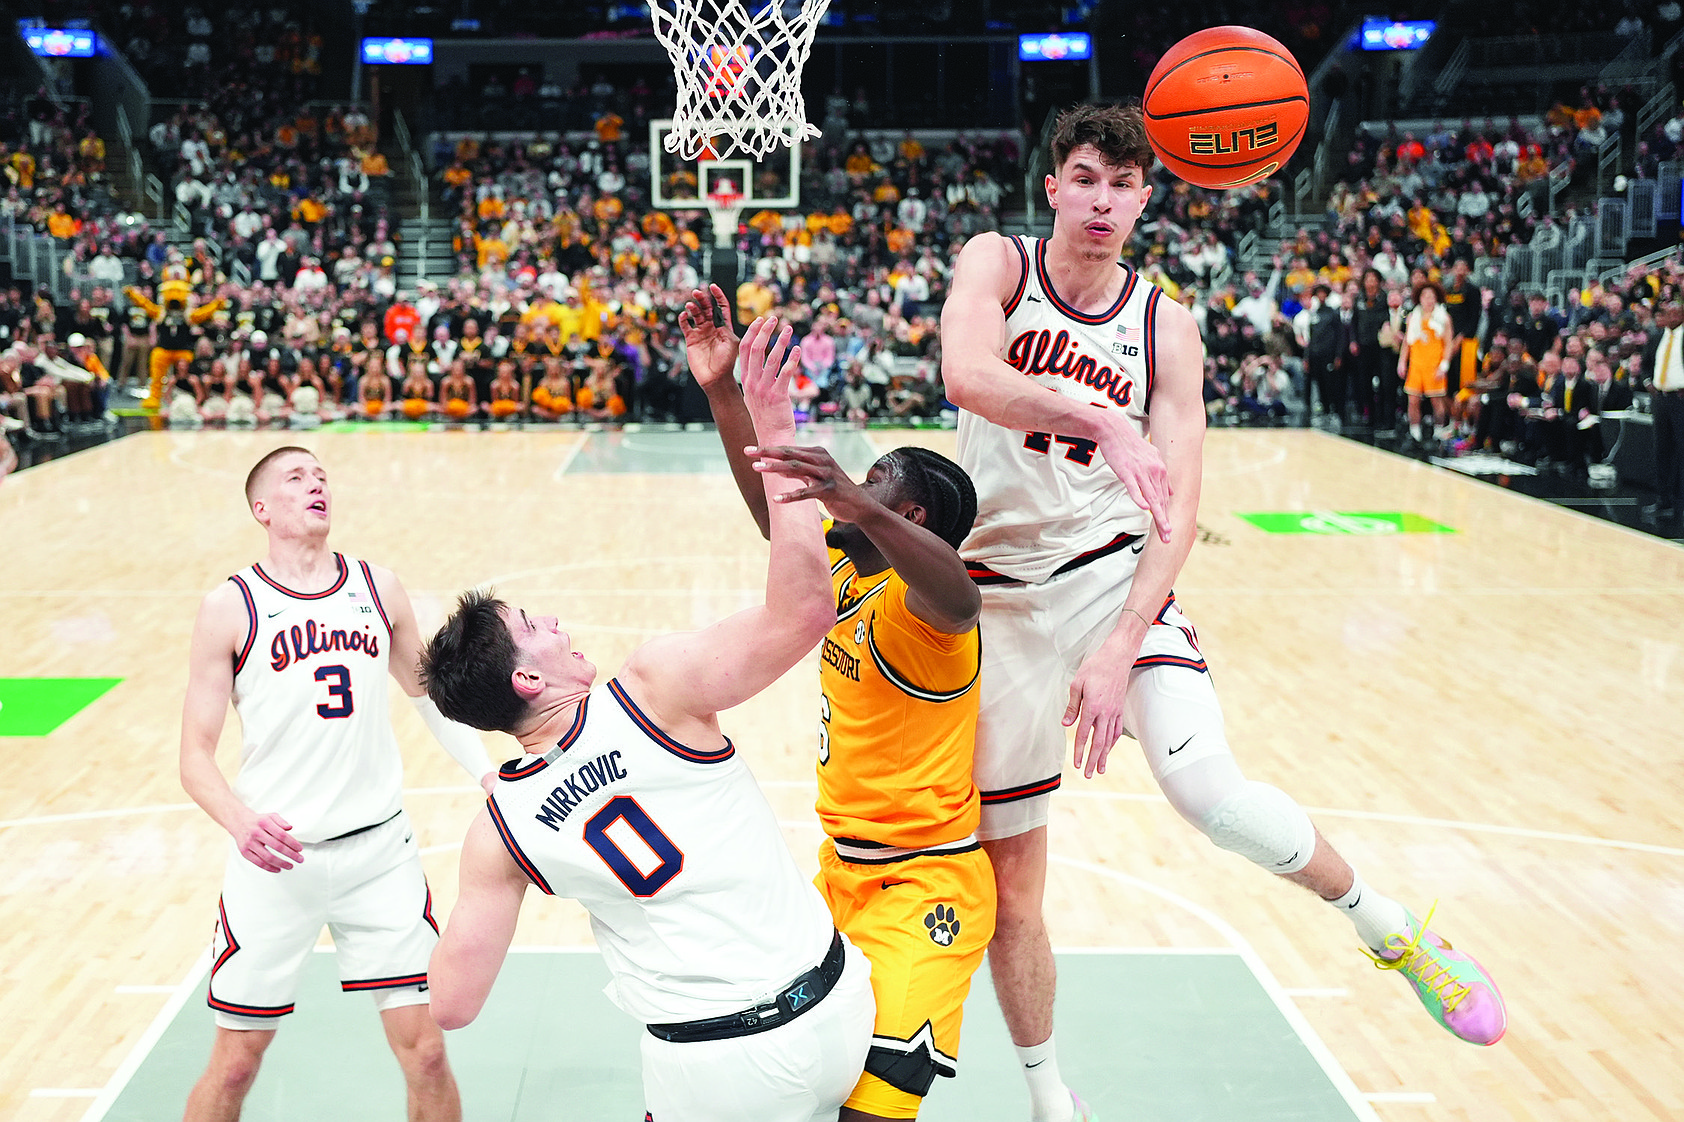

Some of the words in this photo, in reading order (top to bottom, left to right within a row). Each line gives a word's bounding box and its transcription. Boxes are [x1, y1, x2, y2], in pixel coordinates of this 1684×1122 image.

[1189, 121, 1279, 155] ELITE
[1004, 329, 1133, 407] Illinois
[270, 619, 379, 672] Illinois
[822, 636, 861, 682] ISSOURI
[313, 664, 354, 719] 3
[535, 750, 627, 832] MIRKOVIC
[582, 795, 684, 897] 0
[933, 927, 950, 945] M
